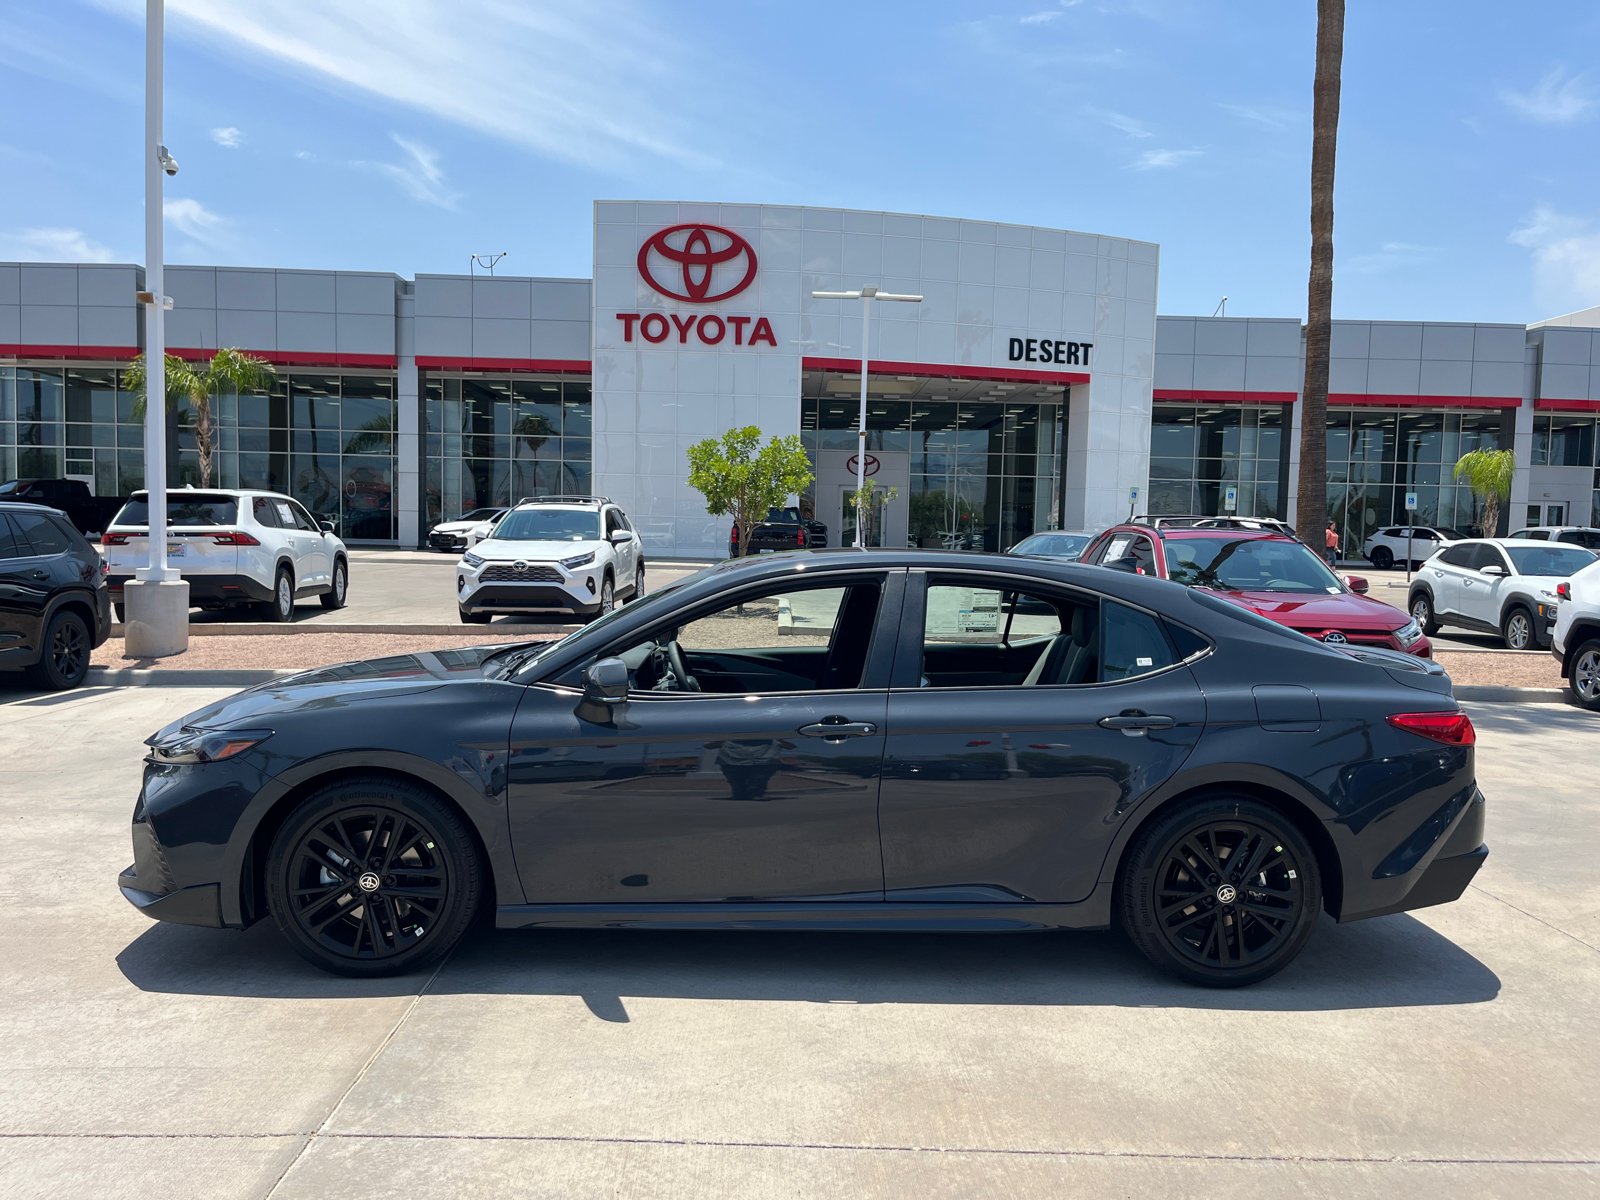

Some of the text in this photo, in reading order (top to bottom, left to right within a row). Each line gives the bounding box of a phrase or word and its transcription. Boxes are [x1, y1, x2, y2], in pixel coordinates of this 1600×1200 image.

[616, 313, 777, 346] TOYOTA
[1009, 338, 1093, 365] DESERT
[340, 790, 388, 802] Continental
[1139, 882, 1152, 927] Continental
